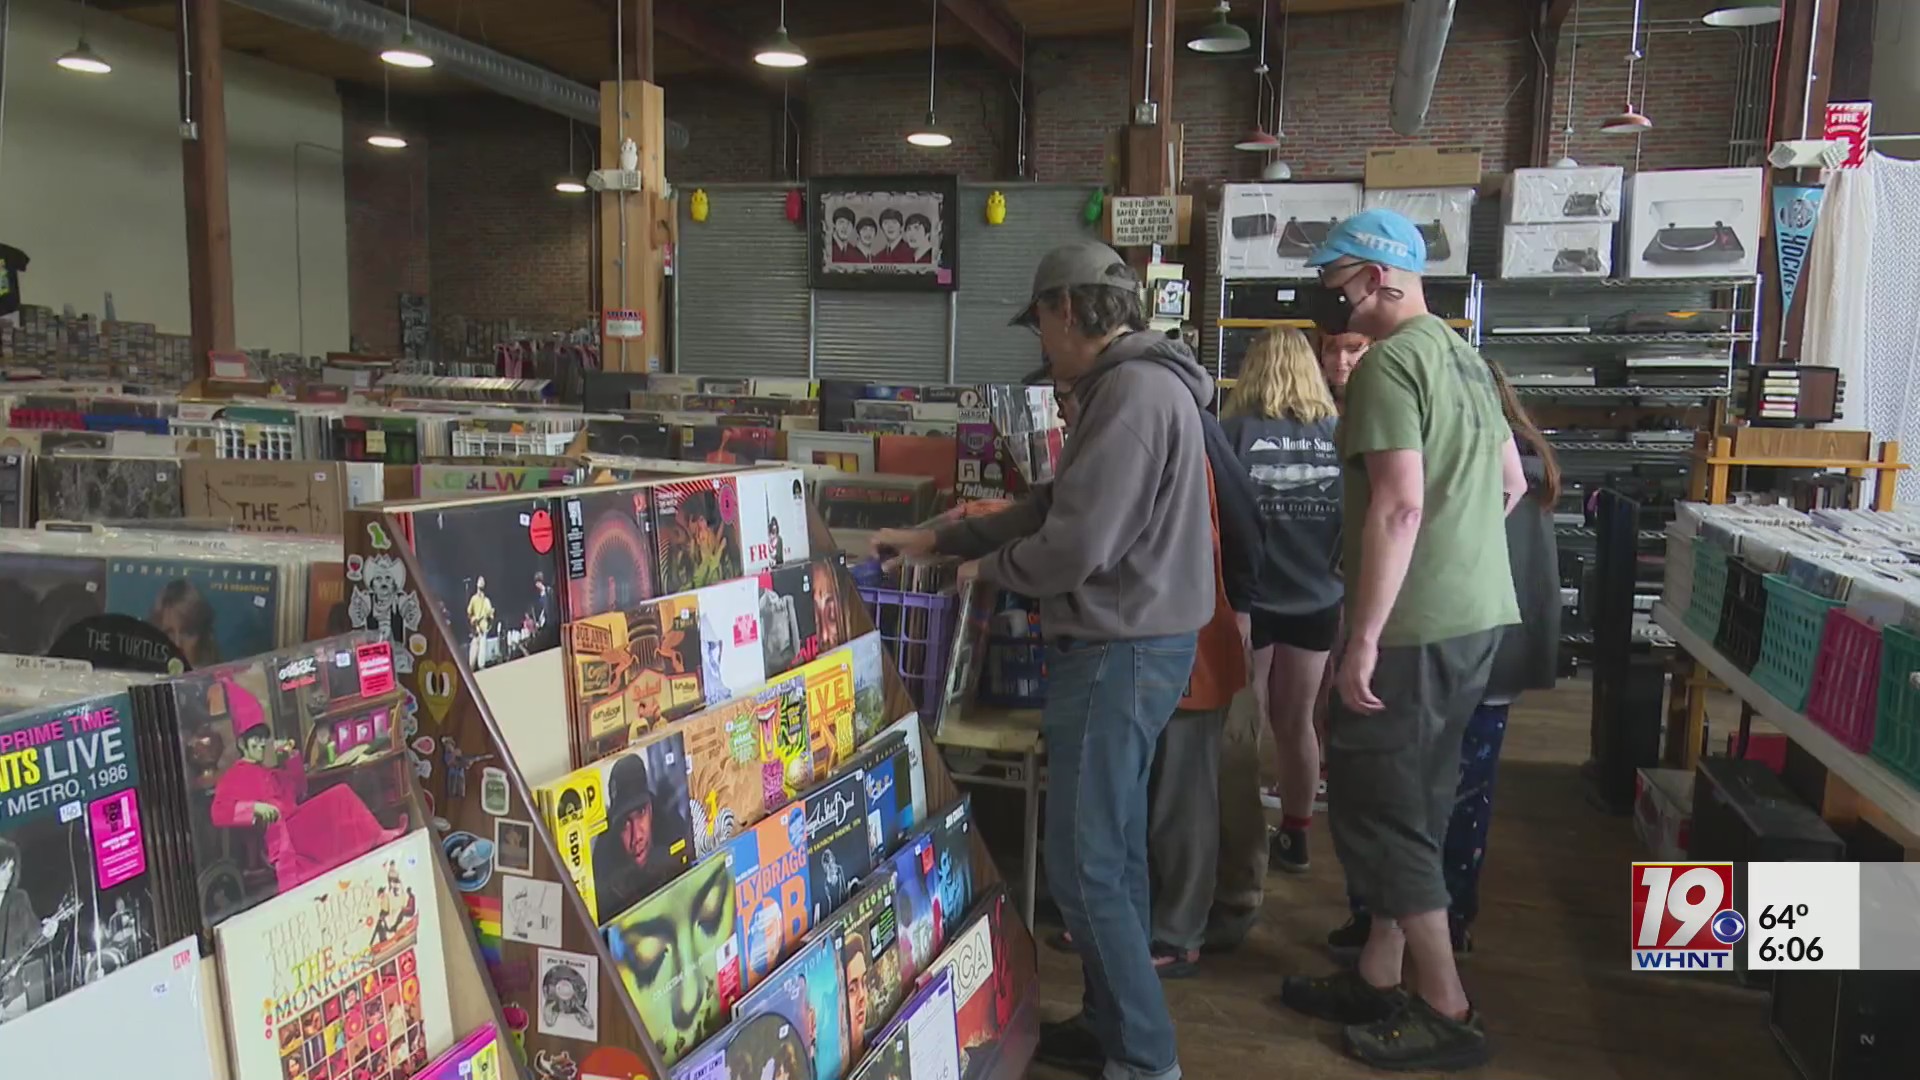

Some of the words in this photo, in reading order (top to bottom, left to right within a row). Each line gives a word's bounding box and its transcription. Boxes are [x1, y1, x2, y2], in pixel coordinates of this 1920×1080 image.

[1831, 111, 1860, 123] FIRE
[1120, 217, 1136, 226] LOAD
[1135, 200, 1155, 208] FLOOR
[1157, 199, 1171, 207] WILL
[1780, 232, 1808, 300] HOCKEY
[236, 502, 281, 522] THE
[113, 562, 191, 577] BONNIE
[208, 567, 272, 581] TYLER
[86, 626, 111, 652] THE
[118, 633, 170, 662] TURTLES
[0, 721, 65, 753] PRIME
[68, 707, 121, 734] TIME:
[44, 727, 126, 781] LIVE
[7, 779, 87, 817] METRO,
[88, 763, 129, 790] 1986
[569, 831, 581, 868] BDP
[763, 846, 806, 893] BRAGG
[274, 948, 374, 1025] MONKEES
[291, 947, 337, 990] THE
